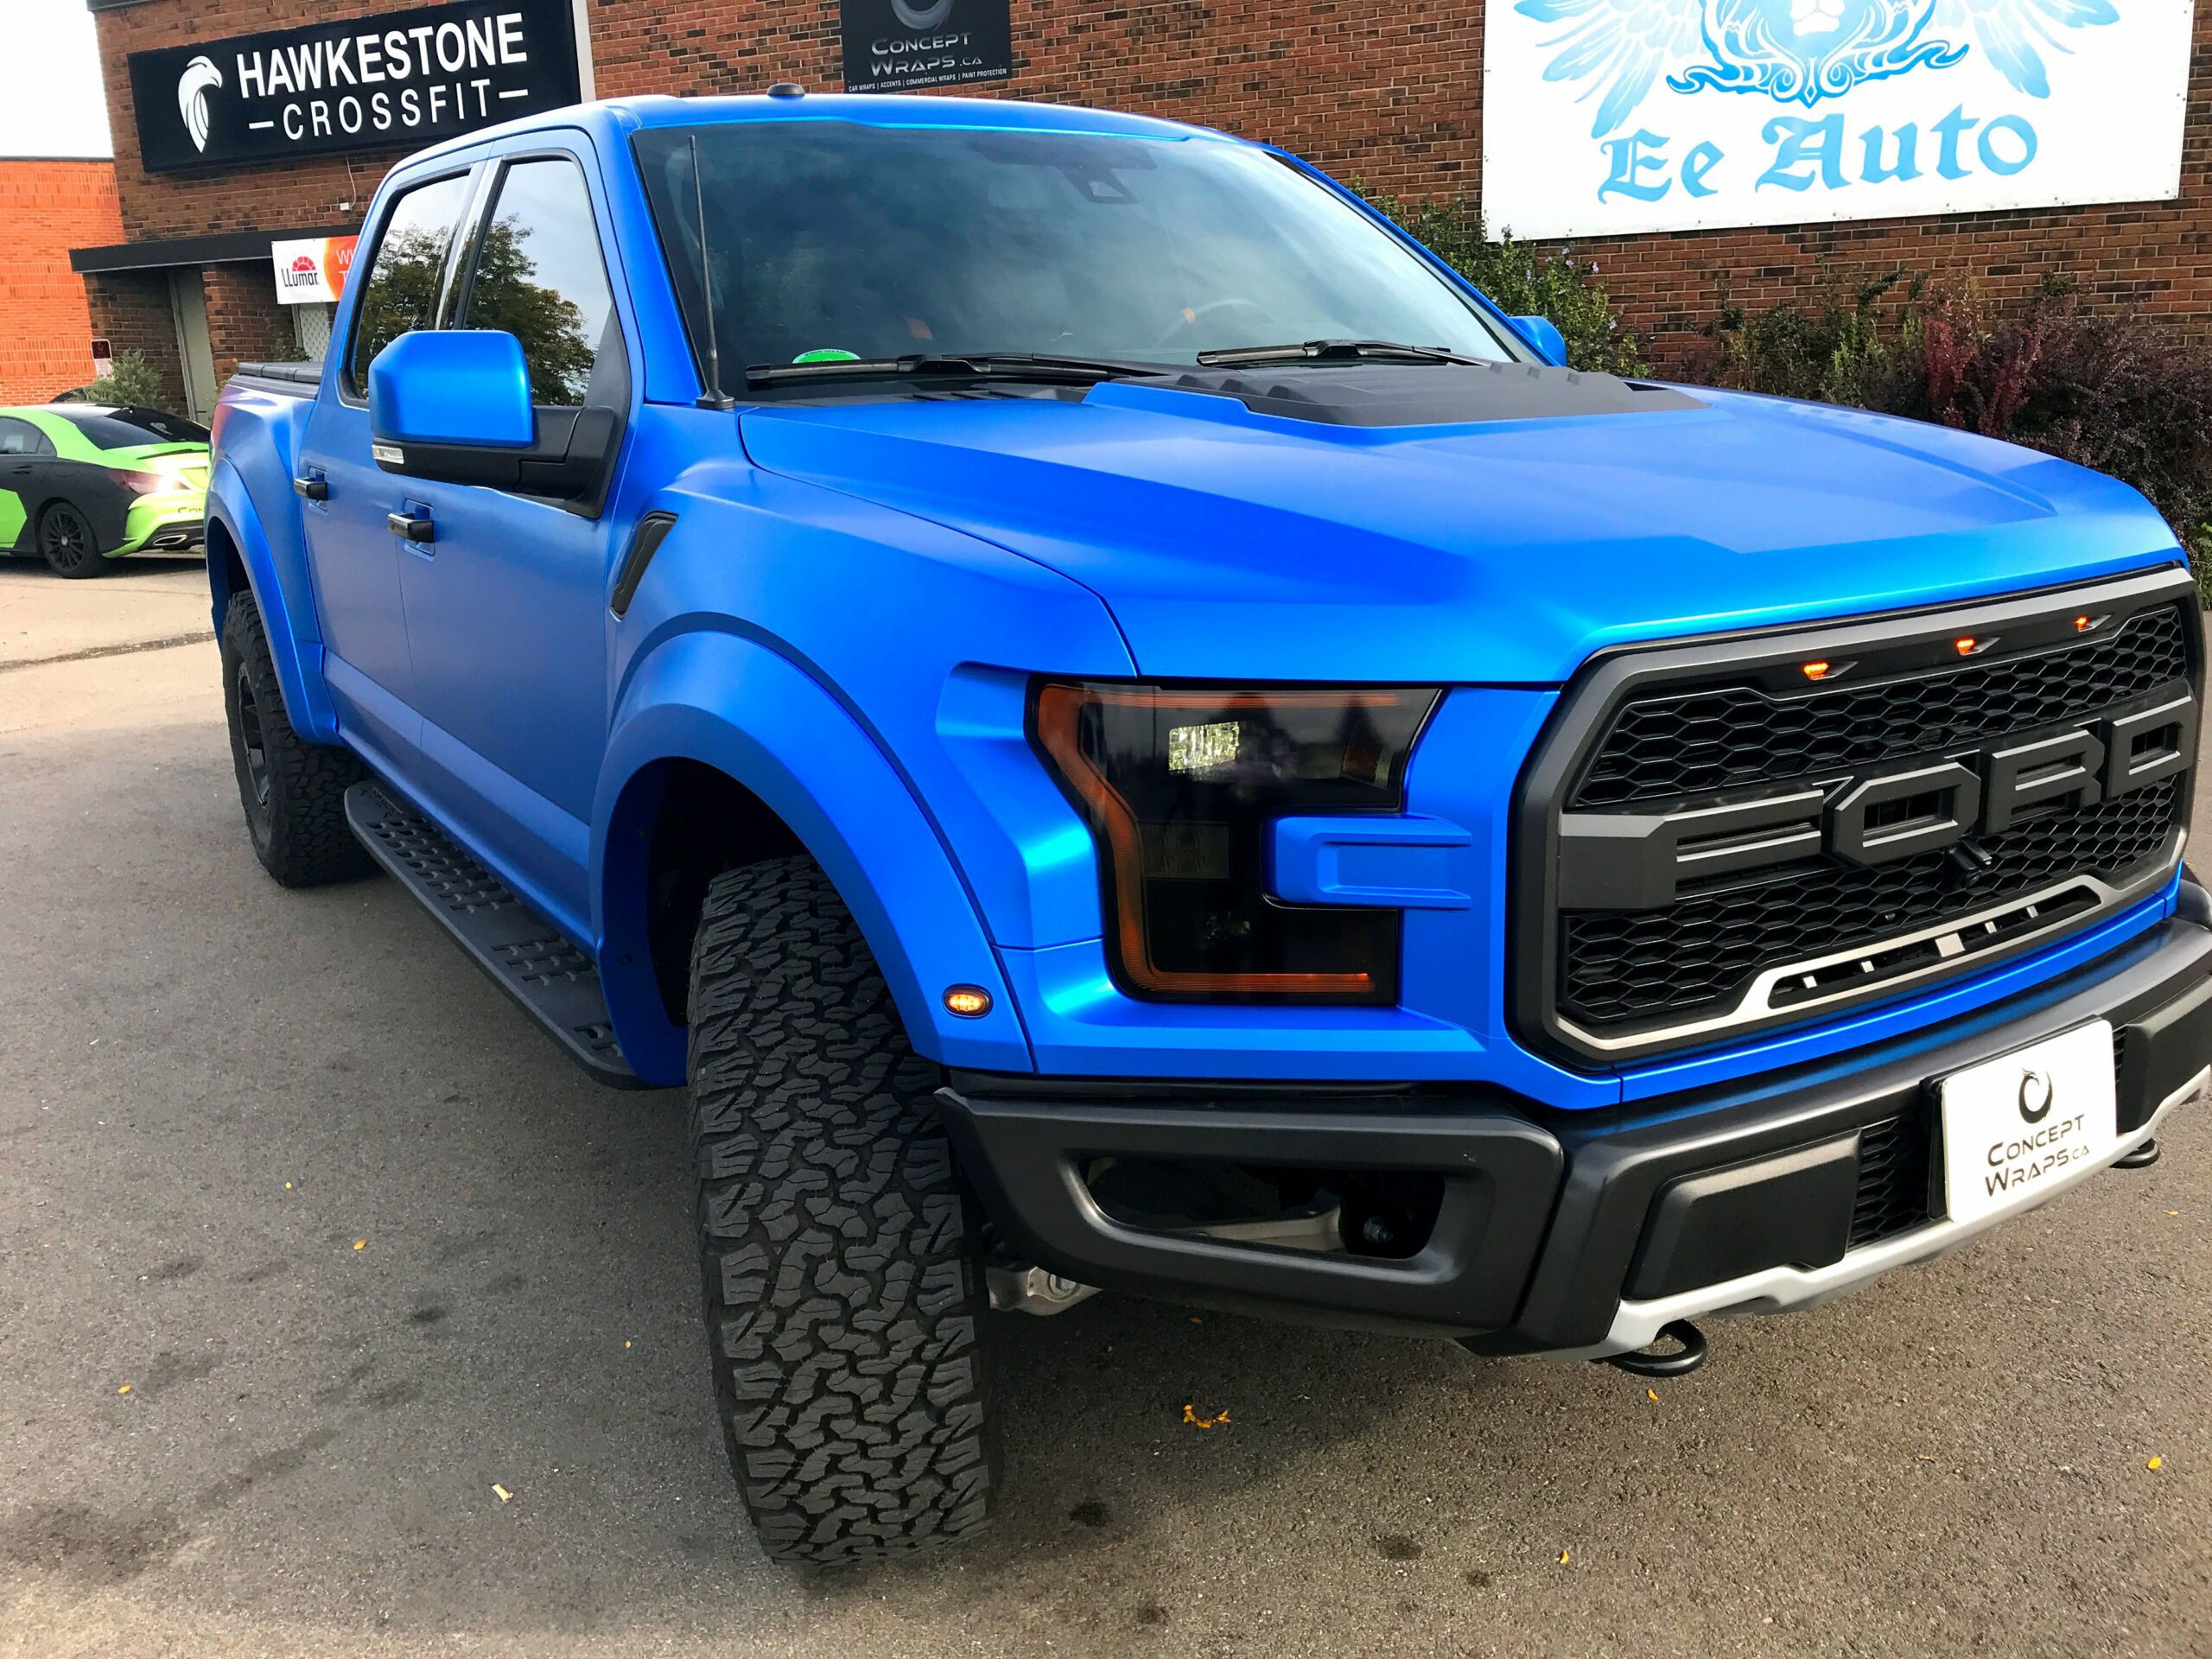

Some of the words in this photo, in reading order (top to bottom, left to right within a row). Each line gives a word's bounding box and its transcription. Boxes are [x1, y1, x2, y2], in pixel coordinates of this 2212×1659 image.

[236, 12, 528, 99] HAWKESTONE
[871, 32, 972, 55] CONCEPT
[880, 79, 901, 88] ACCENTS
[906, 76, 938, 86] COMMERCIAL
[977, 67, 1007, 77] PROTECTION
[283, 79, 491, 141] CROSSFIT
[1596, 127, 1725, 205] Ee
[1754, 103, 2038, 194] Auto
[281, 268, 318, 288] LLumar
[1559, 695, 2195, 908] FORD
[1987, 1114, 2085, 1166] CONCEPT
